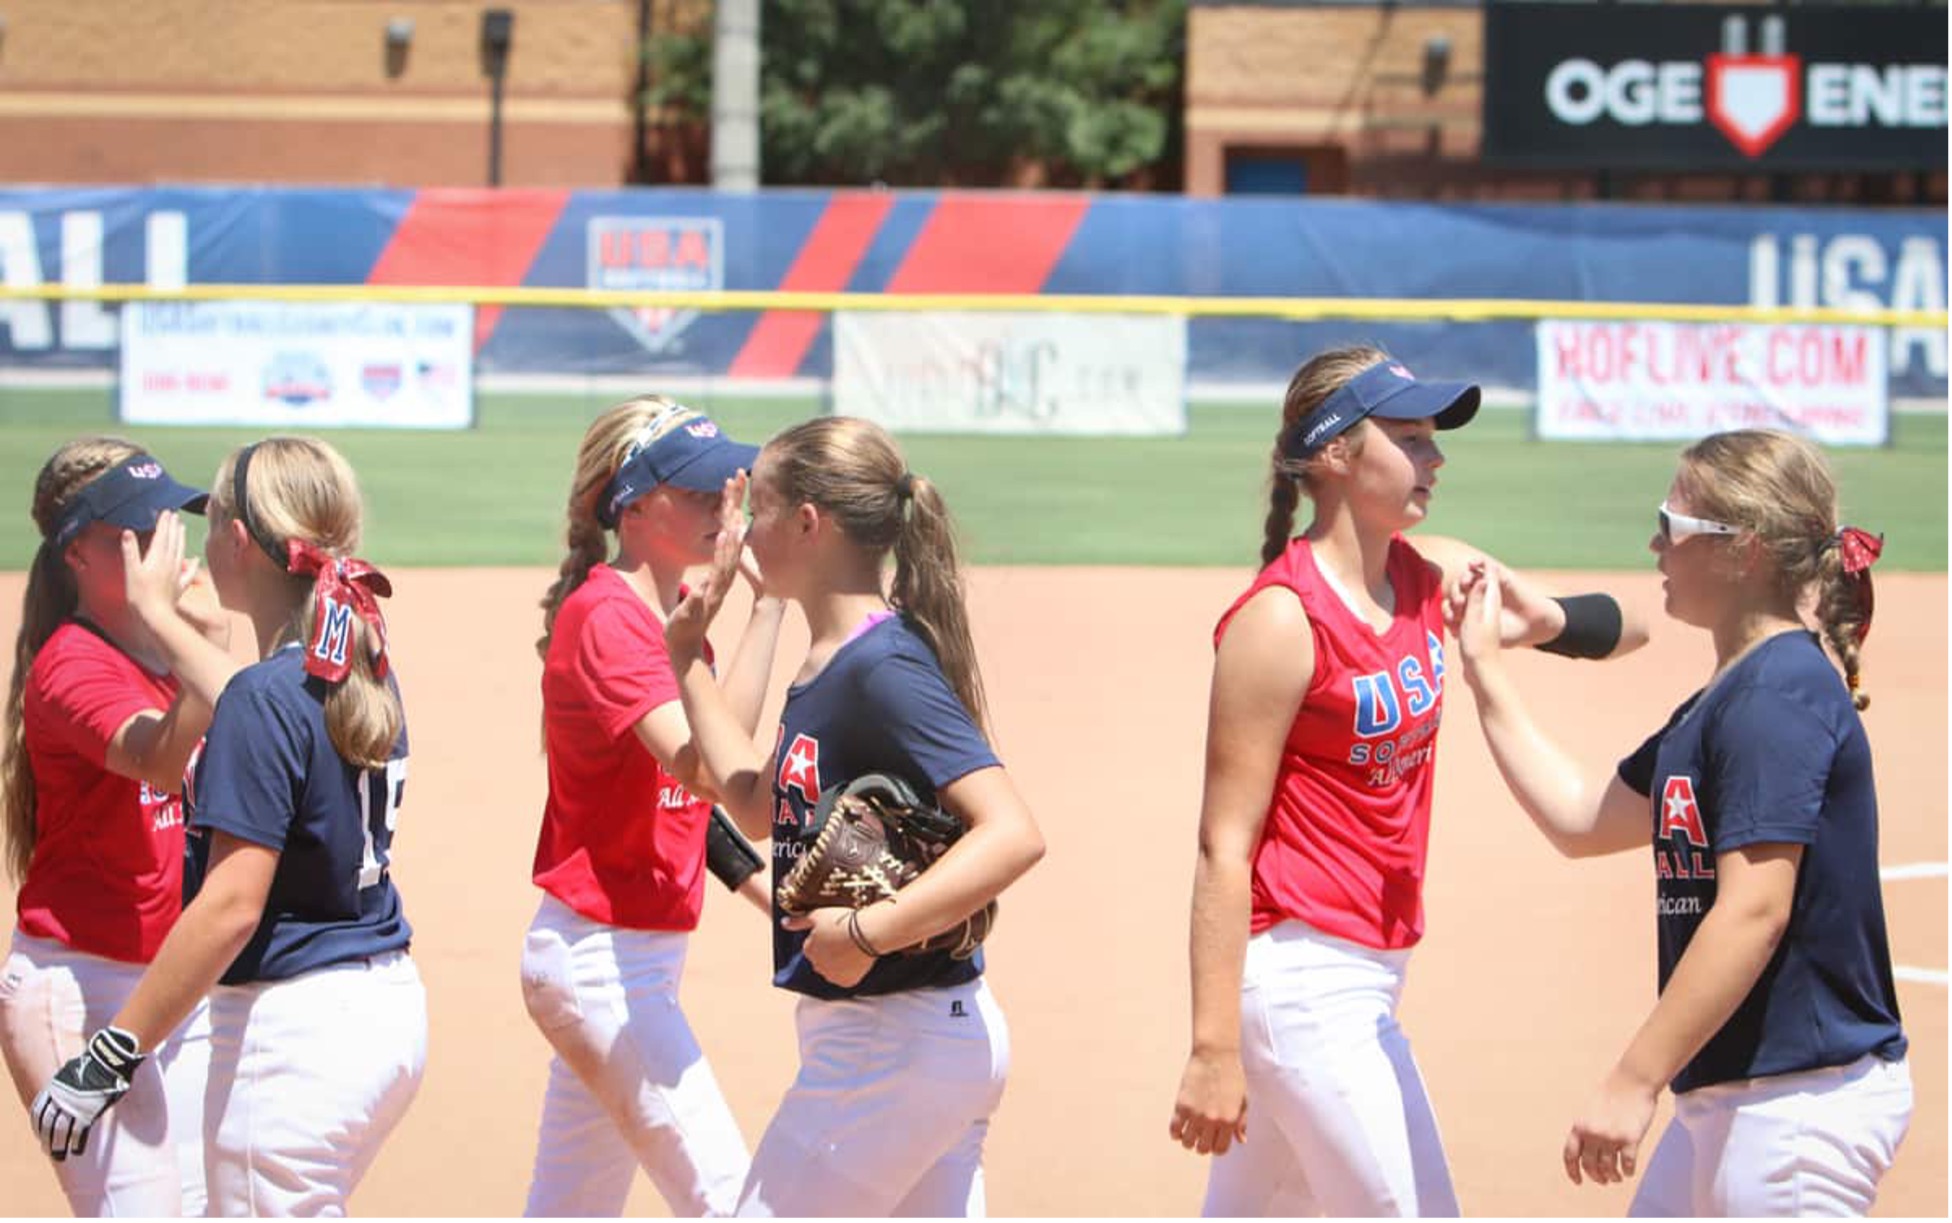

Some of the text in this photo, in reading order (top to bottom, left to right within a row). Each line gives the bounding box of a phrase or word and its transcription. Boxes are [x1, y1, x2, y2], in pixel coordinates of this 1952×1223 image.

[1546, 58, 1704, 125] OGE
[600, 229, 708, 271] USA
[315, 597, 352, 666] M
[775, 723, 821, 803] A
